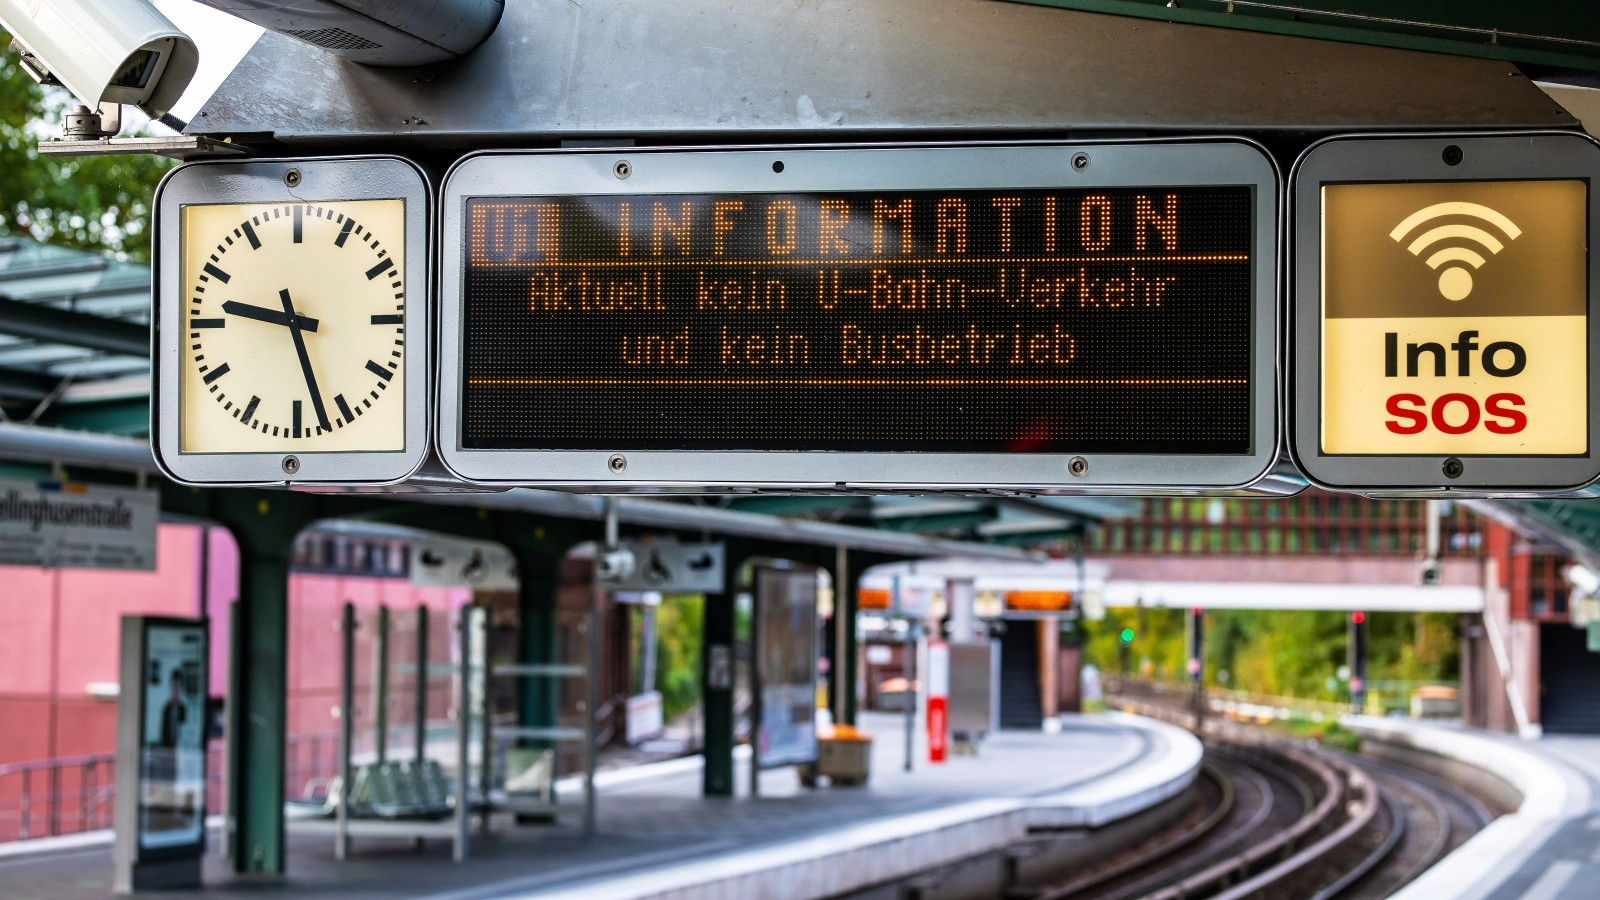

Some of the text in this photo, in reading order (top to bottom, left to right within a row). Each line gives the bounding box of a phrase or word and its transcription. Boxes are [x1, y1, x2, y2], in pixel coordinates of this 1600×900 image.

[484, 195, 1179, 262] U1 INFORMATION
[529, 268, 1177, 311] Aktuell kein U-Bahn-Verkehr
[622, 324, 1076, 365] und kein Busbetrieb
[1384, 330, 1527, 378] Info
[1384, 392, 1528, 435] SOS
